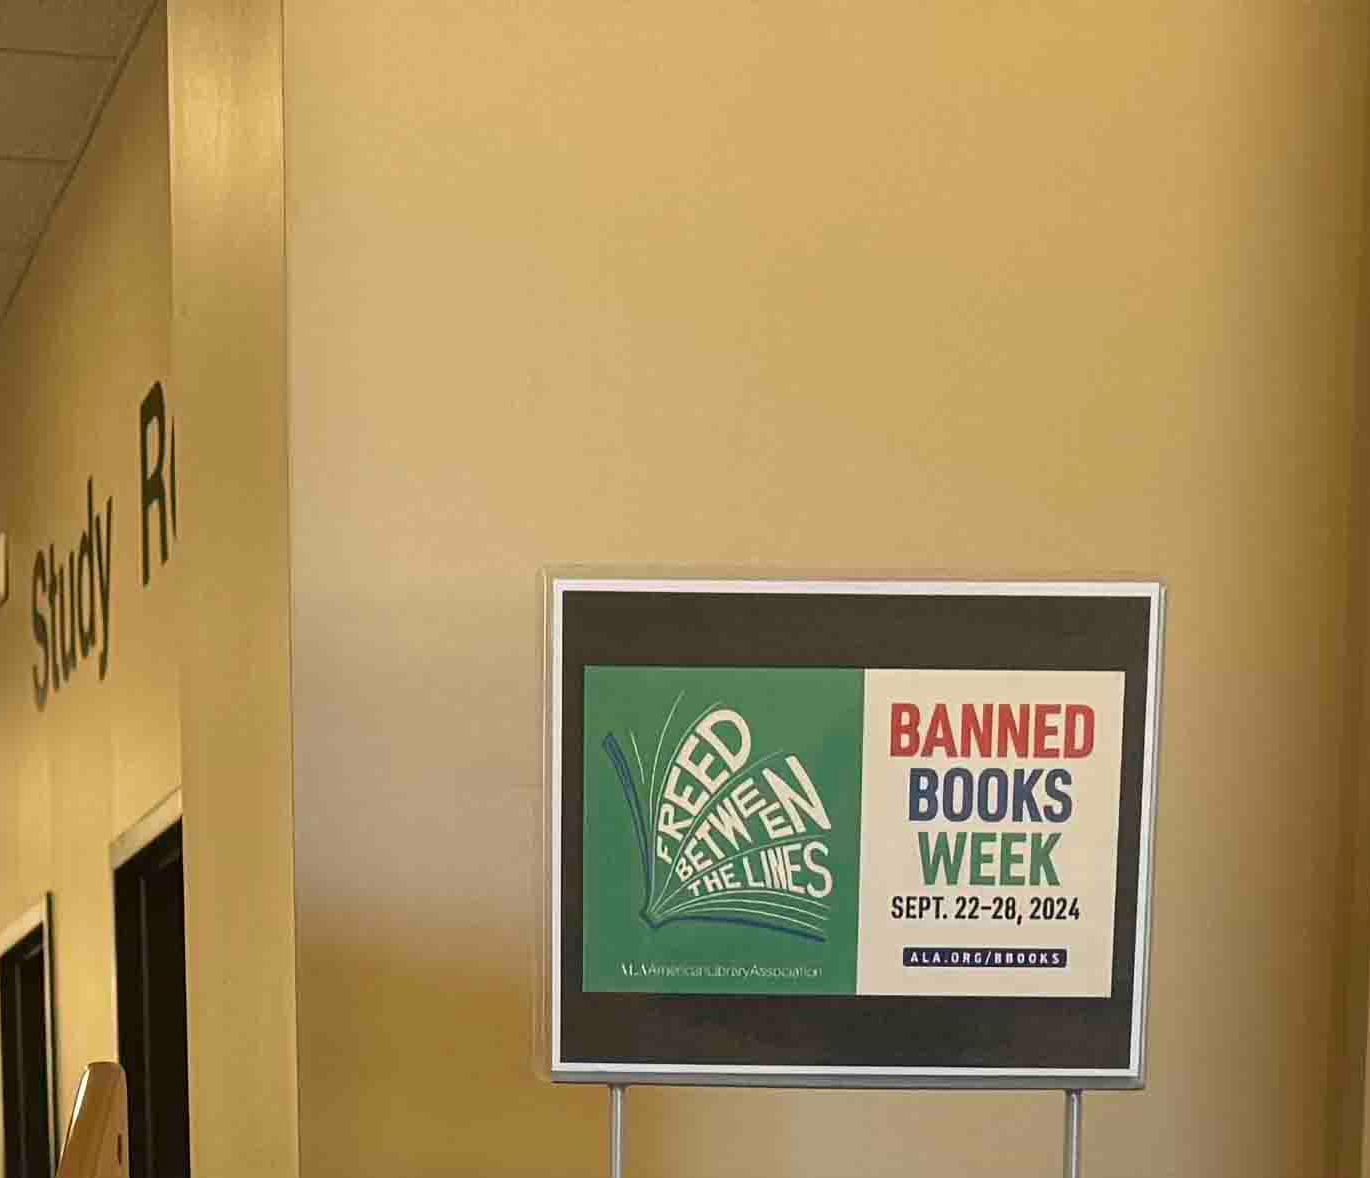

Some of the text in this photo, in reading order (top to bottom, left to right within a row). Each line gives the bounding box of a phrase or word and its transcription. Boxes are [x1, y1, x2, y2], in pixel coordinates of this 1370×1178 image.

[32, 380, 177, 712] Study R
[890, 702, 1096, 760] BANNED
[656, 709, 752, 865] FREED
[908, 768, 1073, 824] BOOKS
[676, 755, 831, 882] BETWEEN
[688, 842, 833, 899] THE LINES
[917, 832, 1061, 887] WEEK
[891, 896, 949, 921] SEPT.
[1029, 898, 1081, 922] 2024
[909, 951, 1062, 967] ALA.ORG/BBOOKS
